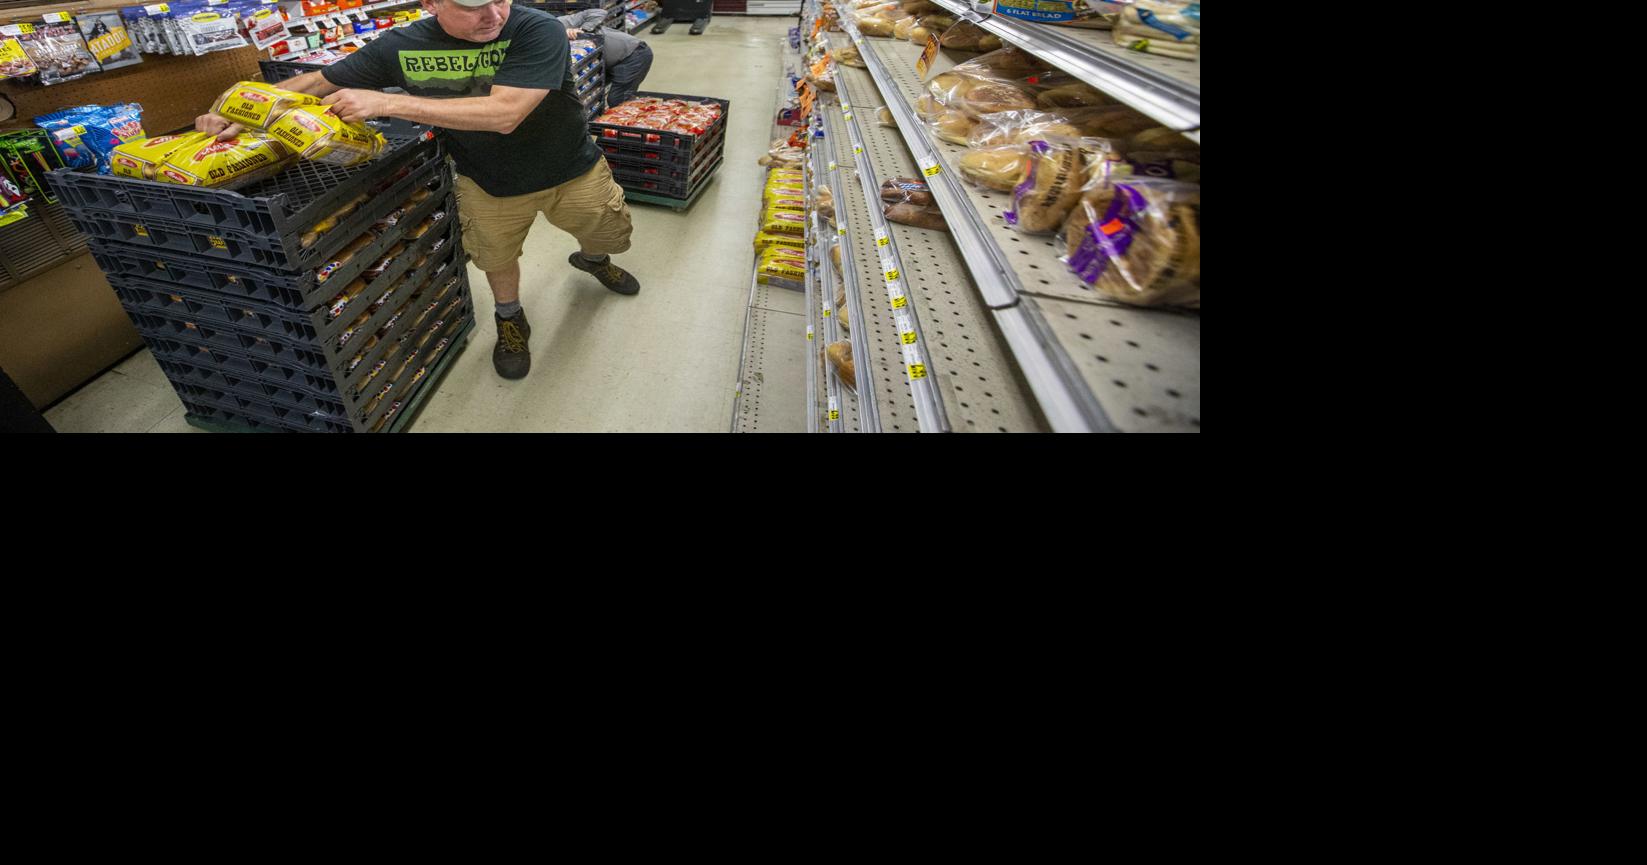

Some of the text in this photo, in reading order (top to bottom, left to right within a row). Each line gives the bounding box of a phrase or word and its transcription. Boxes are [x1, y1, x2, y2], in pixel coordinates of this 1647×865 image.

[90, 30, 127, 54] ATADOR
[241, 102, 254, 111] OLD
[226, 106, 261, 121] FASHIONED
[289, 126, 303, 136] OLD
[208, 167, 226, 179] OLD
